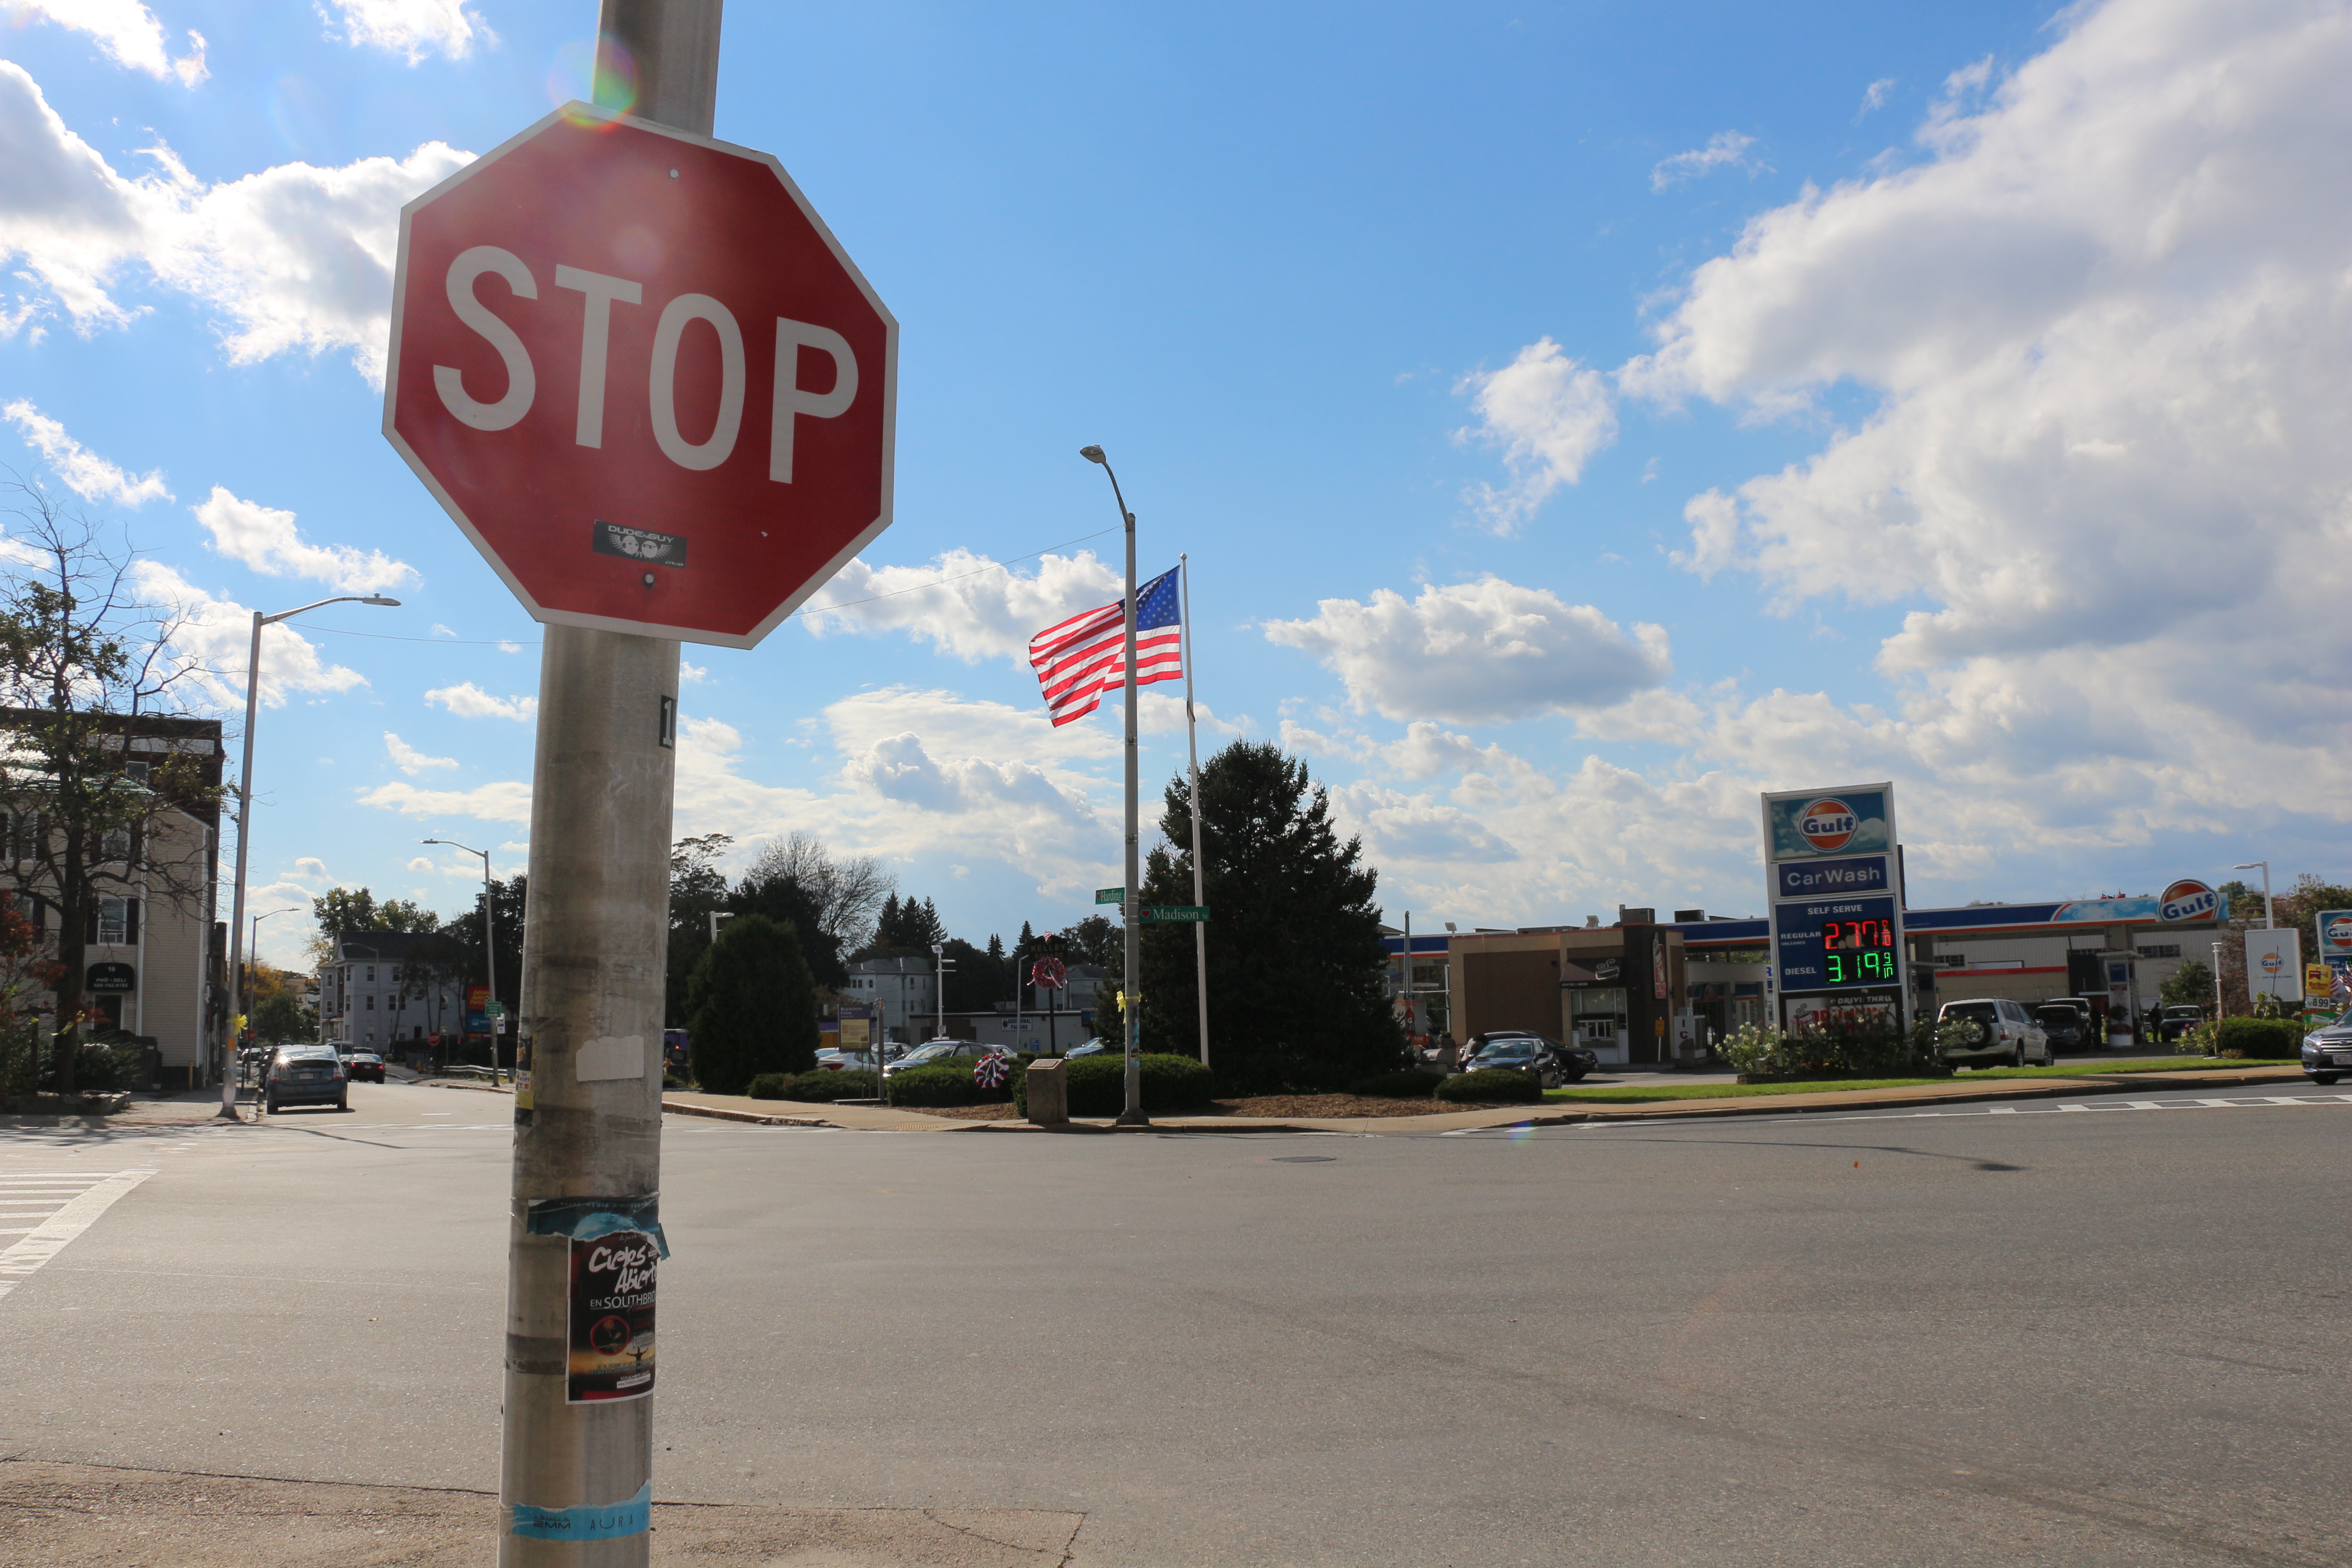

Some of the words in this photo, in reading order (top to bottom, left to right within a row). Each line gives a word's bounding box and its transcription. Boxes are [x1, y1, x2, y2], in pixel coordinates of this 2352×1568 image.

[433, 245, 858, 484] STOP
[663, 700, 672, 746] 1
[1803, 817, 1853, 834] Gulf
[1787, 872, 1822, 887] Car
[1825, 867, 1880, 883] Wash
[1101, 890, 1122, 902] Harding
[1153, 908, 1199, 920] Madison
[1808, 906, 1830, 915] SELF
[1833, 905, 1862, 913] SERVE
[2162, 893, 2214, 920] Gulf
[1031, 944, 1066, 952] KELLEY
[1785, 967, 1817, 975] DIESEL
[1680, 1019, 1688, 1039] IC
